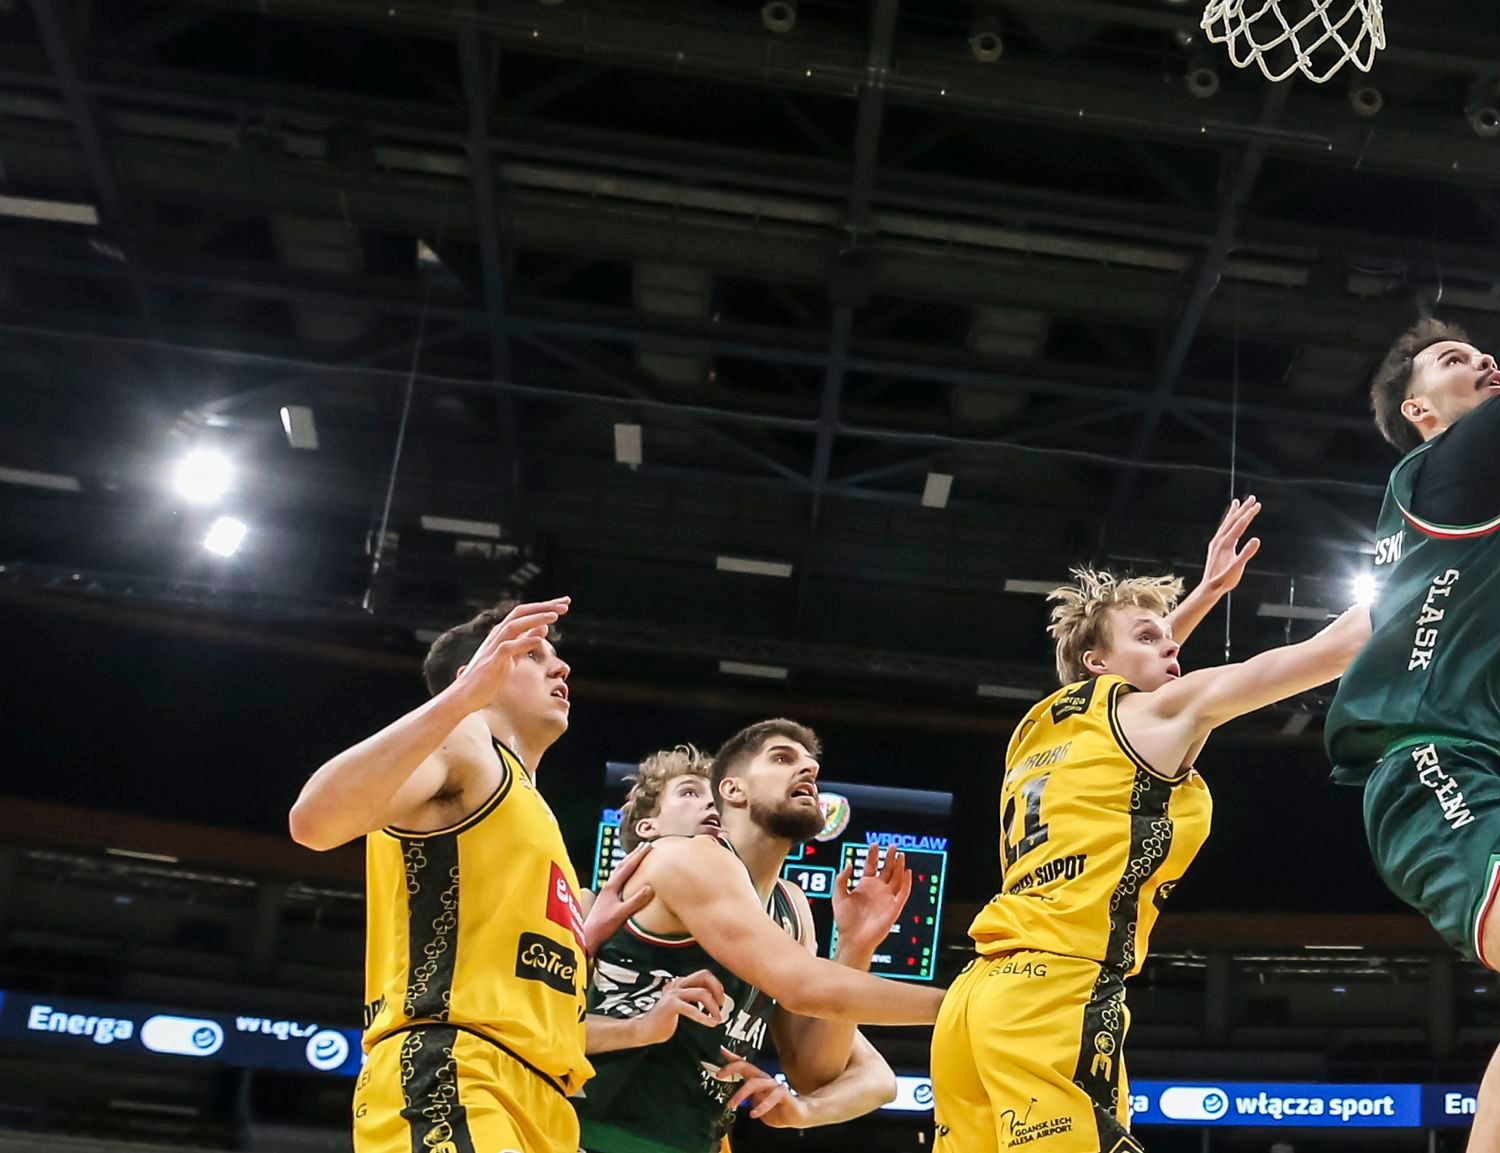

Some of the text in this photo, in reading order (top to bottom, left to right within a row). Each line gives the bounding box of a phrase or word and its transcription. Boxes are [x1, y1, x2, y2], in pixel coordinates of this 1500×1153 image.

[1375, 529, 1402, 565] SKI
[865, 832, 947, 850] WROCLAW
[797, 871, 827, 891] 18
[1034, 854, 1087, 886] SOPOT
[549, 951, 577, 985] Tre
[27, 1005, 134, 1044] Energa
[1235, 1092, 1396, 1121] włącza sport
